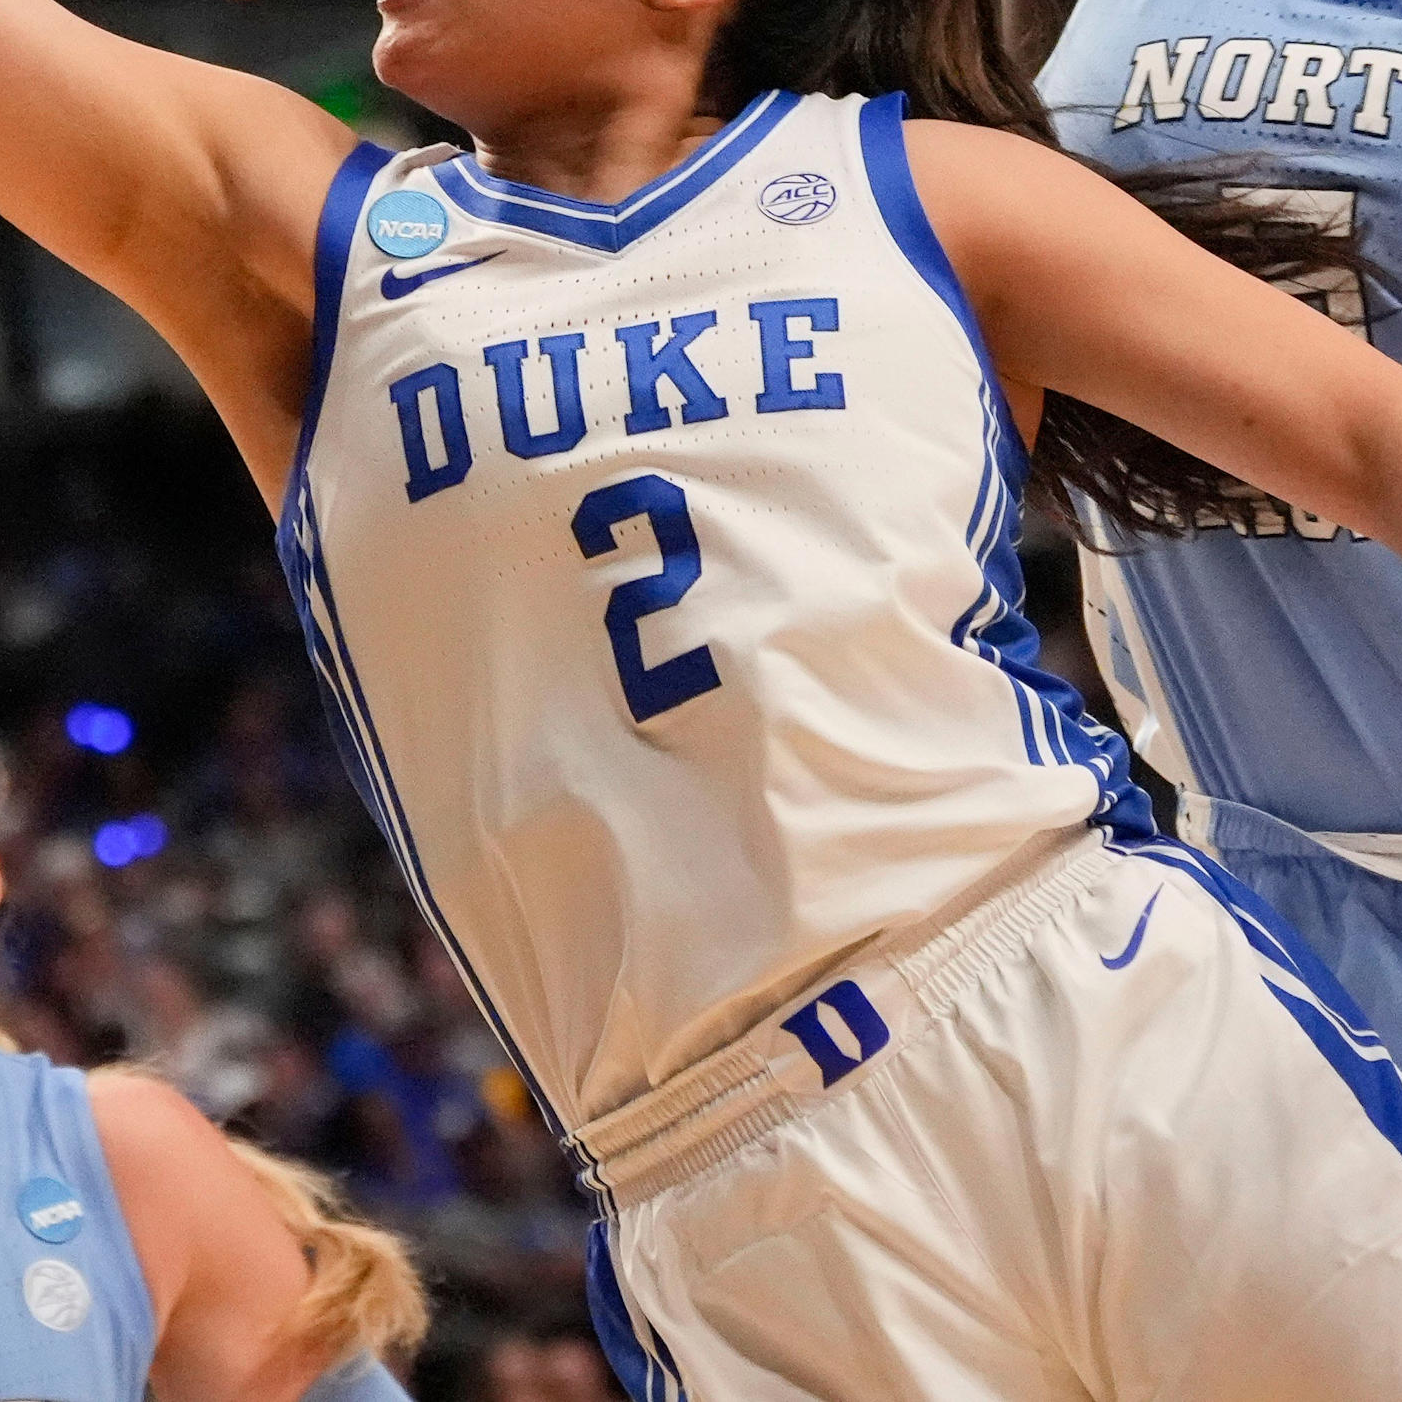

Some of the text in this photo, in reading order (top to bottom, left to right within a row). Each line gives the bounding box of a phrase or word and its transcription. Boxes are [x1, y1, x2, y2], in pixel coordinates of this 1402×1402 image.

[378, 219, 444, 240] NCAA
[770, 183, 830, 203] ACC
[390, 297, 847, 504] DUKE
[570, 473, 723, 725] 2
[780, 979, 891, 1089] D
